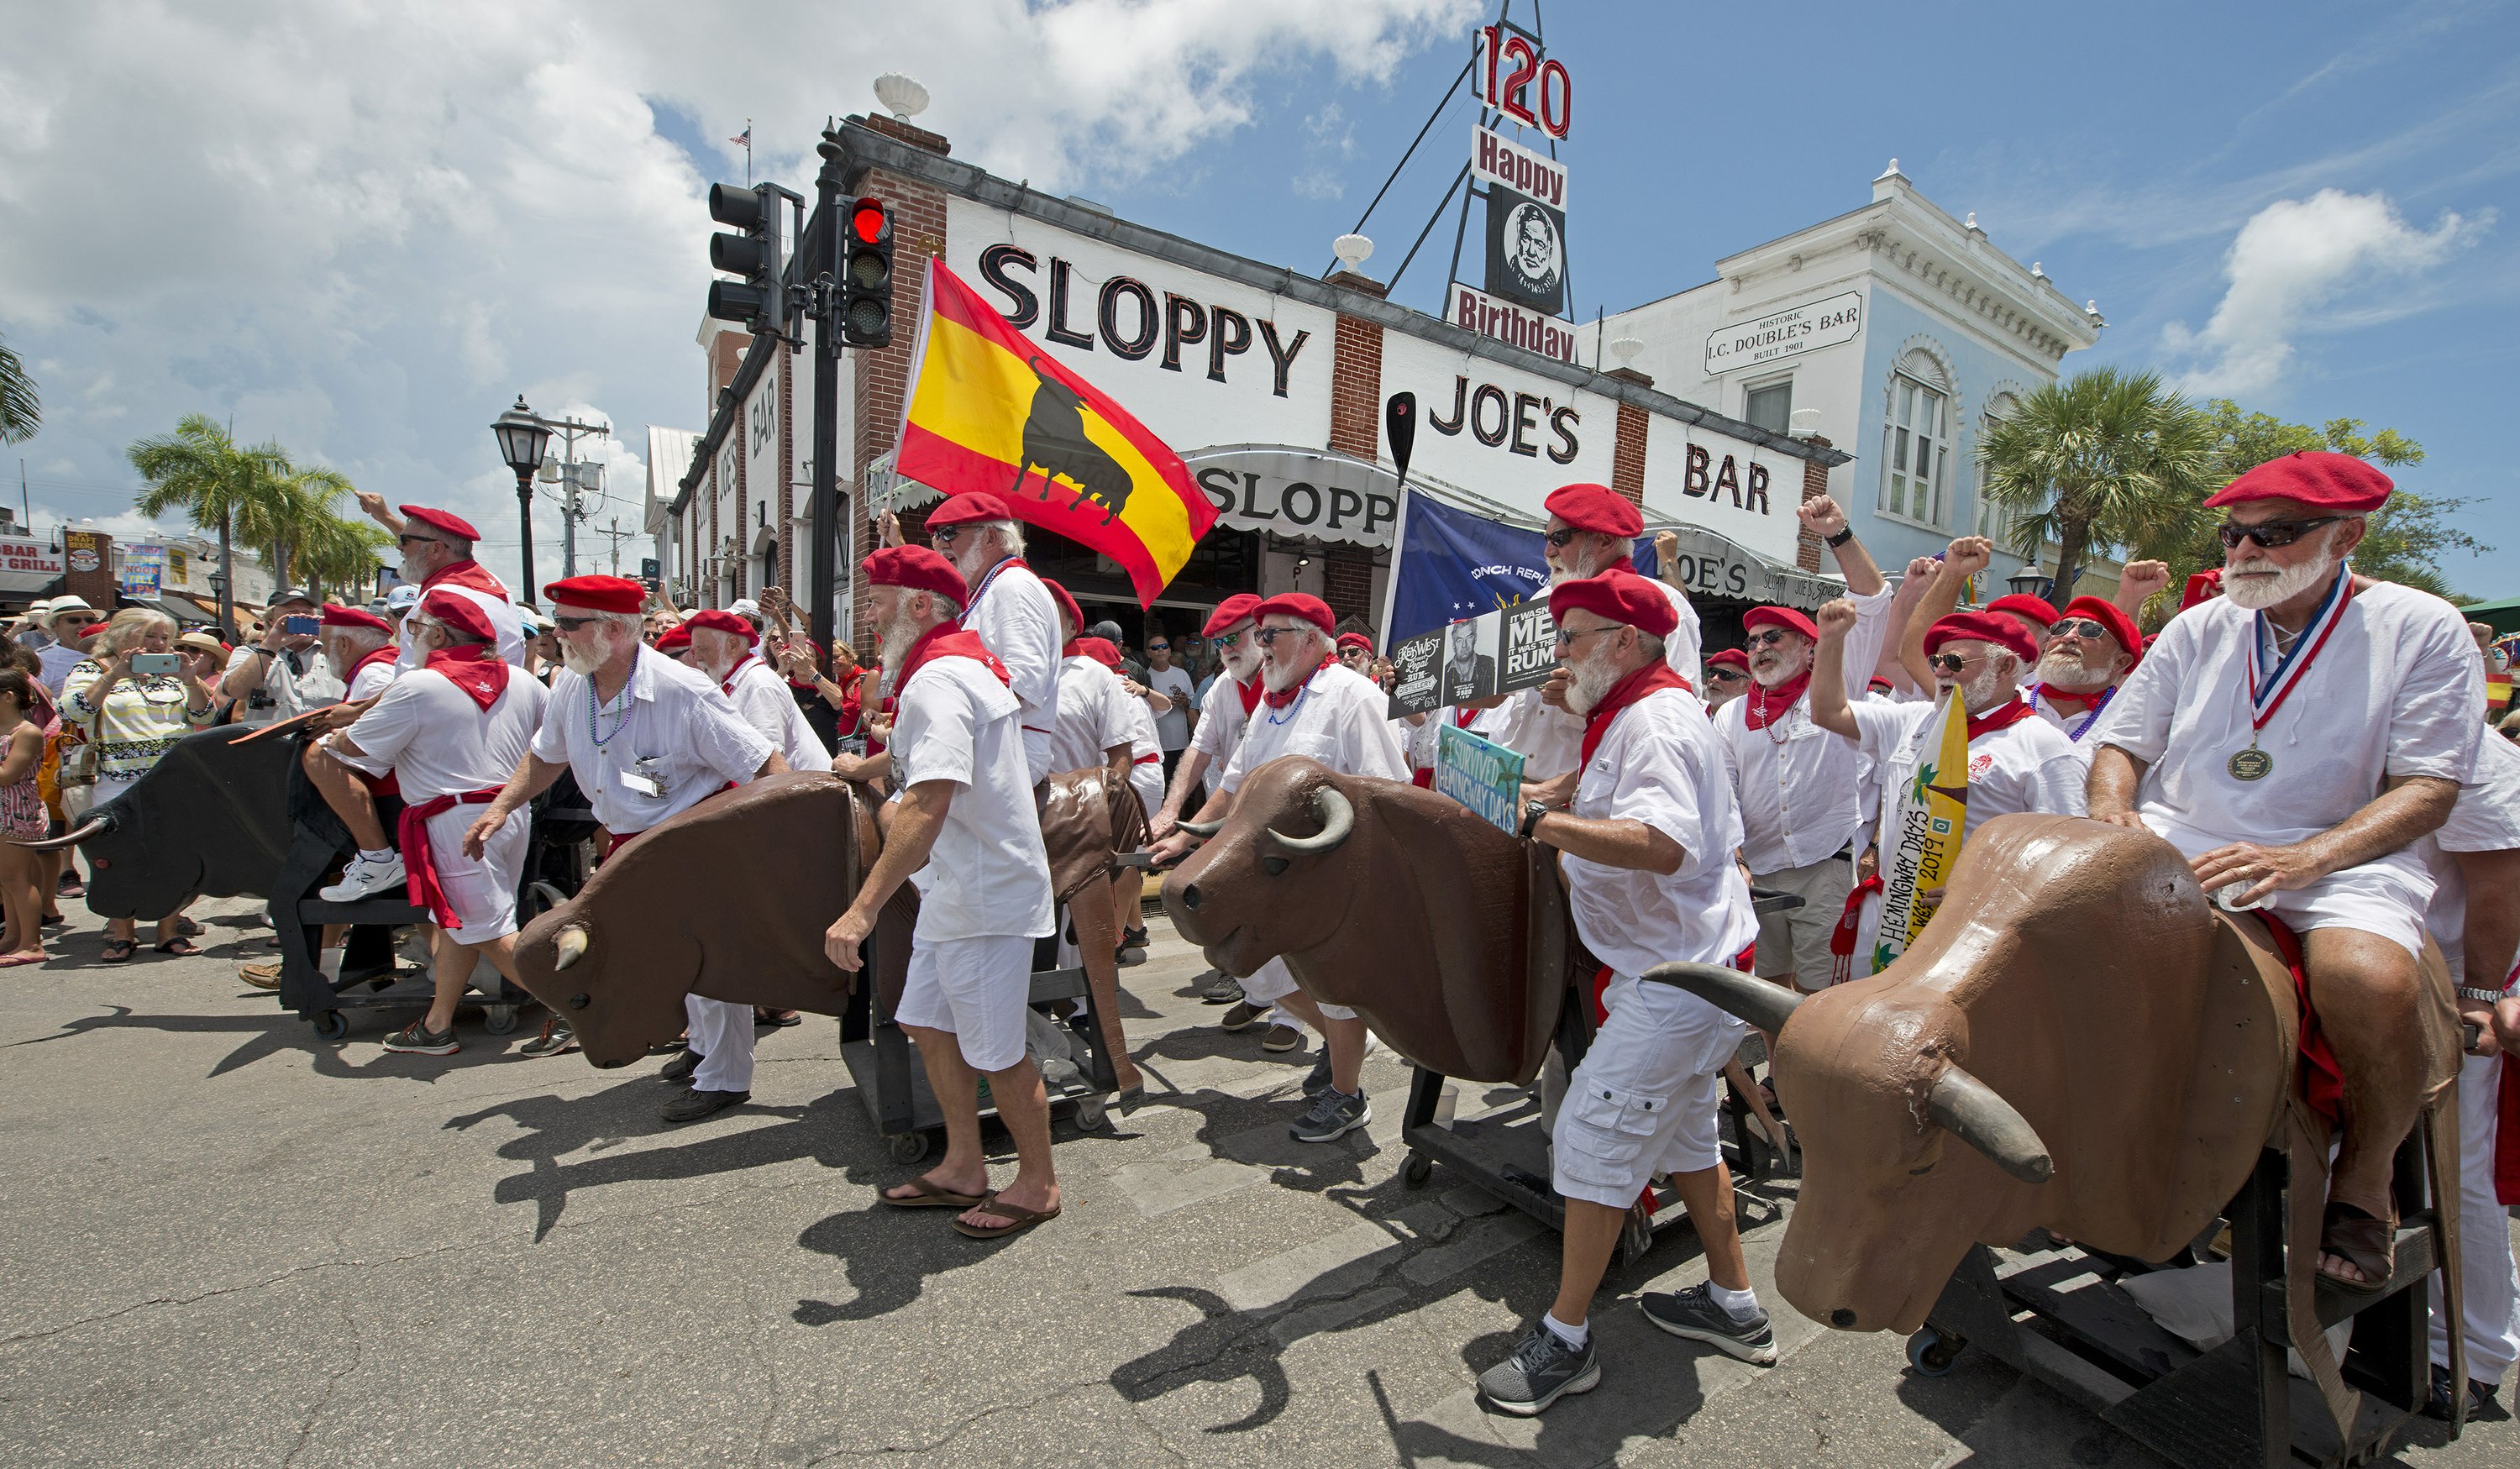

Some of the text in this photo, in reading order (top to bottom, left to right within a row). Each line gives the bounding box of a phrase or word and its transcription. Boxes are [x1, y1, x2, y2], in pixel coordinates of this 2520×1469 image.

[1480, 26, 1571, 139] 120
[1479, 130, 1564, 206] Happy
[979, 243, 1310, 398] SLOPPY
[1458, 290, 1573, 363] Birthday
[1708, 307, 1857, 359] I.C. DOUBLE'S BAR
[1759, 311, 1804, 329] HISTORIC
[1753, 341, 1804, 361] BUILT 1901
[753, 377, 774, 460] BAR
[1429, 374, 1581, 465] JOE'S
[719, 434, 737, 502] JOE'S
[1683, 443, 1772, 516] BAR
[1196, 468, 1396, 533] SLOPP
[0, 544, 38, 557] BAR
[67, 536, 97, 544] DRAFT
[8, 558, 61, 571] GRILL
[125, 565, 159, 574] NOON
[1516, 567, 1550, 587] REPU
[1656, 554, 1746, 594] OE'S
[1795, 579, 1813, 596] JOE'S
[1508, 612, 1557, 649] ME
[1510, 606, 1550, 623] IT WASN
[1507, 645, 1557, 674] RUM
[1508, 637, 1557, 656] IT WAS THE
[1399, 679, 1433, 694] DISTILLERY
[1407, 670, 1425, 682] RUM
[1446, 736, 1499, 788] I SURVIVED
[1439, 761, 1515, 834] HEMINGWAY DAYS
[1881, 811, 1929, 943] HEMINGWAY DAYS
[1919, 838, 1944, 881] 2019
